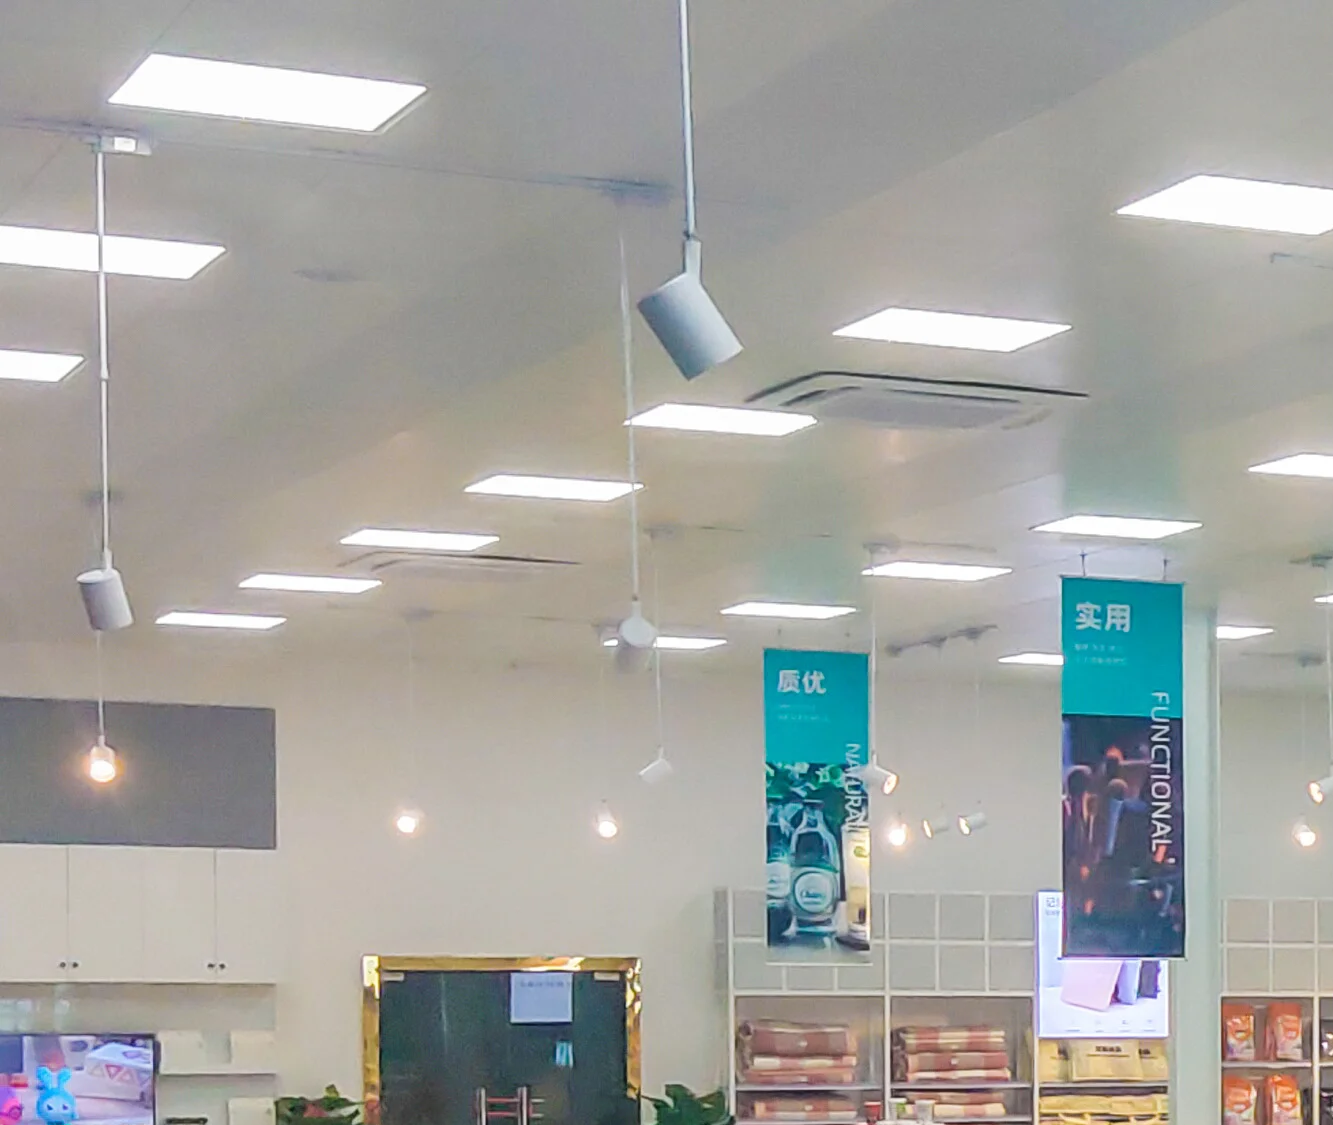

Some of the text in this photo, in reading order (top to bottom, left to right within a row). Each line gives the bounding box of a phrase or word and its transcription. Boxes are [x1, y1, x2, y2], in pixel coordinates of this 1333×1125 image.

[1075, 602, 1131, 632] 实用
[777, 669, 827, 694] 质优
[1150, 692, 1172, 852] FUNCTIONAL
